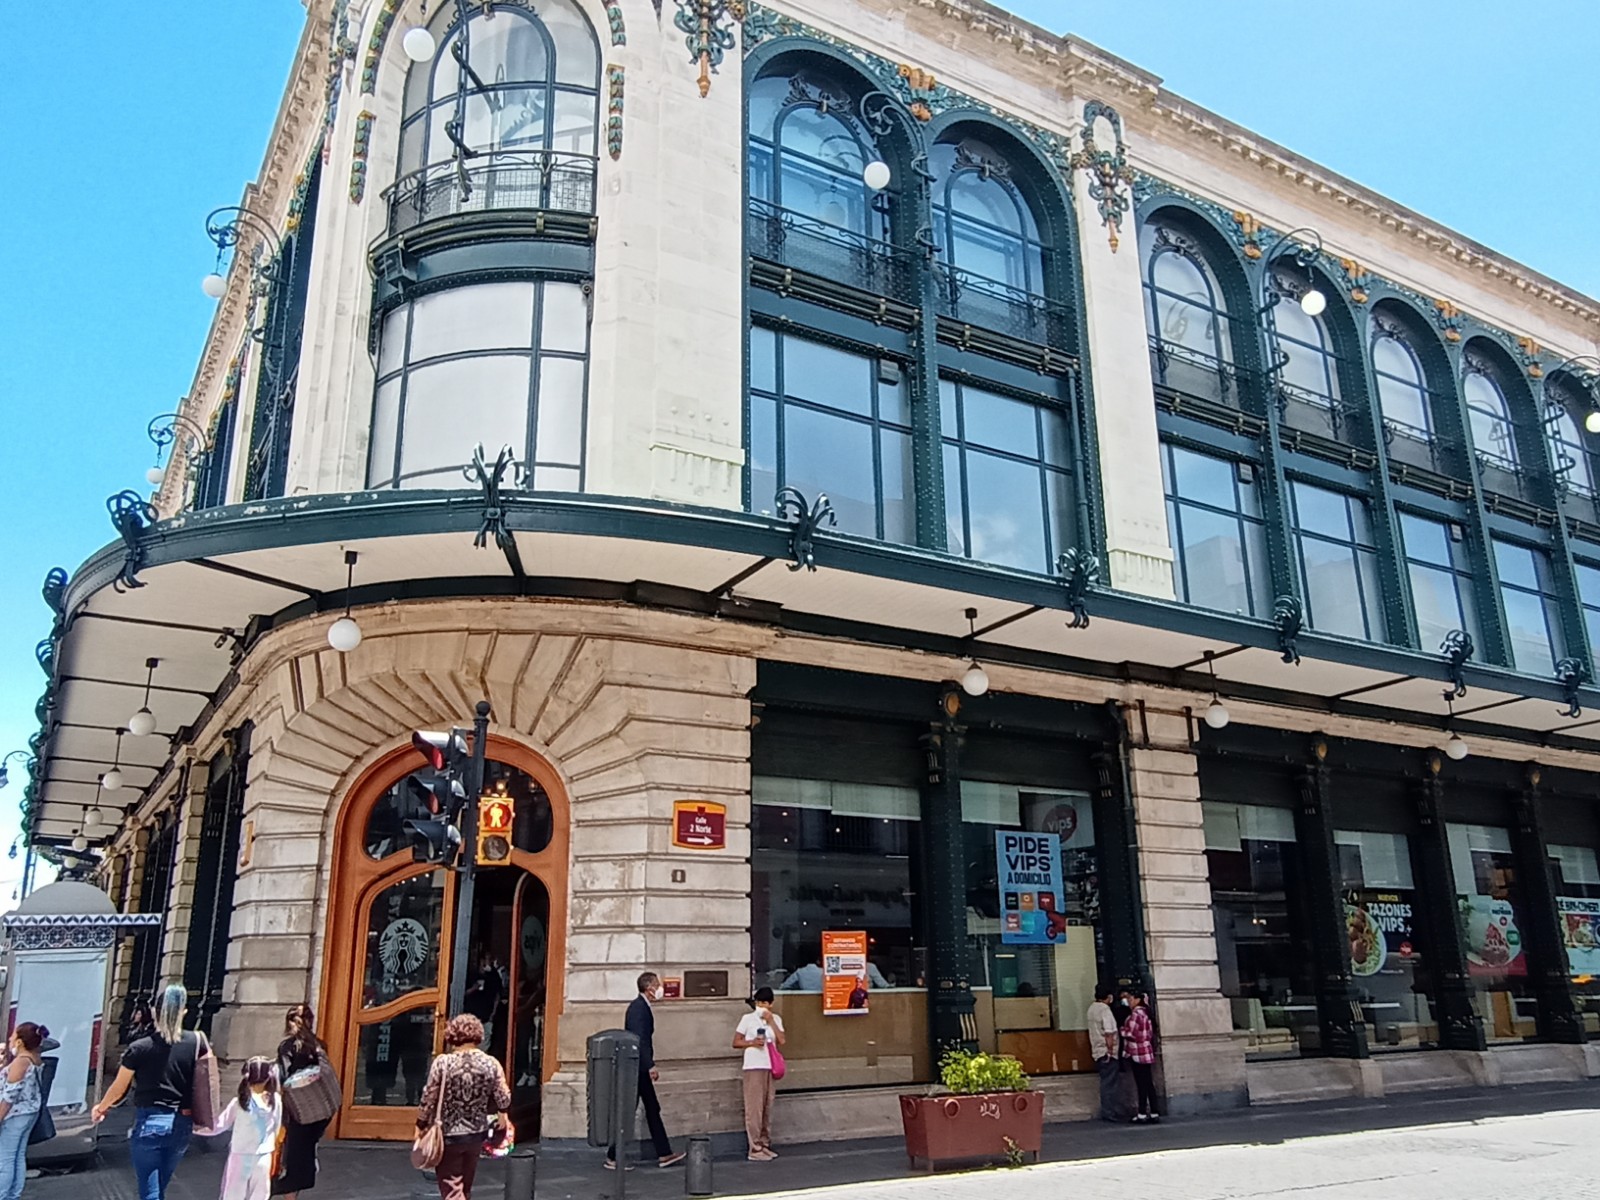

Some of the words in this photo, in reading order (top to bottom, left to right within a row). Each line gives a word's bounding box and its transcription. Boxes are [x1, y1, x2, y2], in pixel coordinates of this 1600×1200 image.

[695, 824, 711, 833] Norte
[1004, 835, 1050, 854] PIDE
[1007, 872, 1014, 885] A
[1014, 872, 1052, 886] DOMICILIO
[1366, 902, 1413, 918] TAZONES
[1378, 916, 1406, 933] VIPS
